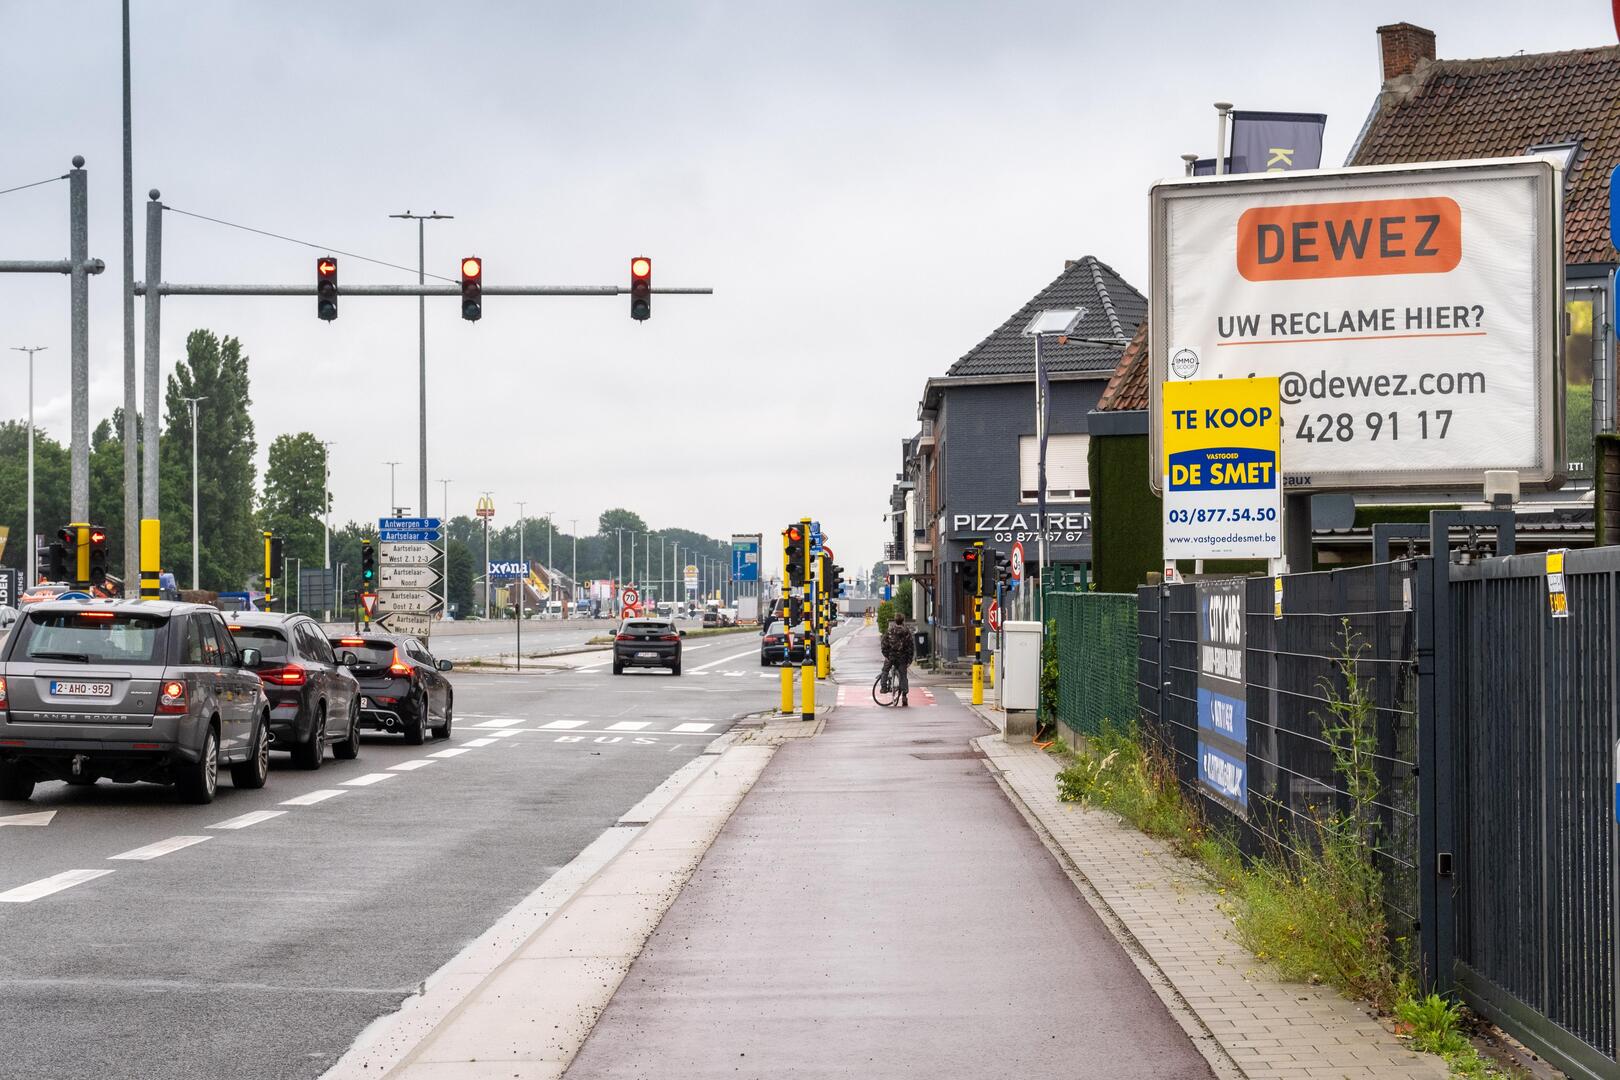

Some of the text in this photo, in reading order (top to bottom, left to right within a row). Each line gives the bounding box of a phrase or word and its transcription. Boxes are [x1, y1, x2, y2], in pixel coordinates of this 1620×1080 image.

[1257, 214, 1441, 264] DEWEZ
[1217, 304, 1485, 339] UW RECLAME HIER?
[1279, 369, 1486, 405] @dewez.com
[1171, 406, 1273, 430] TE KOOP
[1295, 413, 1354, 443] 428
[1364, 411, 1399, 441] 91
[1417, 409, 1453, 440] 17
[1206, 452, 1239, 460] VASTGOED
[1171, 461, 1273, 486] DE SMET
[384, 519, 430, 529] Antwerpen 9
[953, 512, 1029, 531] PIZZA
[1169, 507, 1277, 525] 03/877.54.50
[386, 532, 429, 540] Aartselaar 2
[994, 531, 1083, 543] 03 877 67 67
[1169, 532, 1276, 546] www.vastgoeddesmet.be
[389, 555, 403, 563] West
[625, 593, 636, 602] 70
[1209, 595, 1223, 643] CITY
[1223, 594, 1241, 645] CARS
[553, 735, 661, 745] BUS
